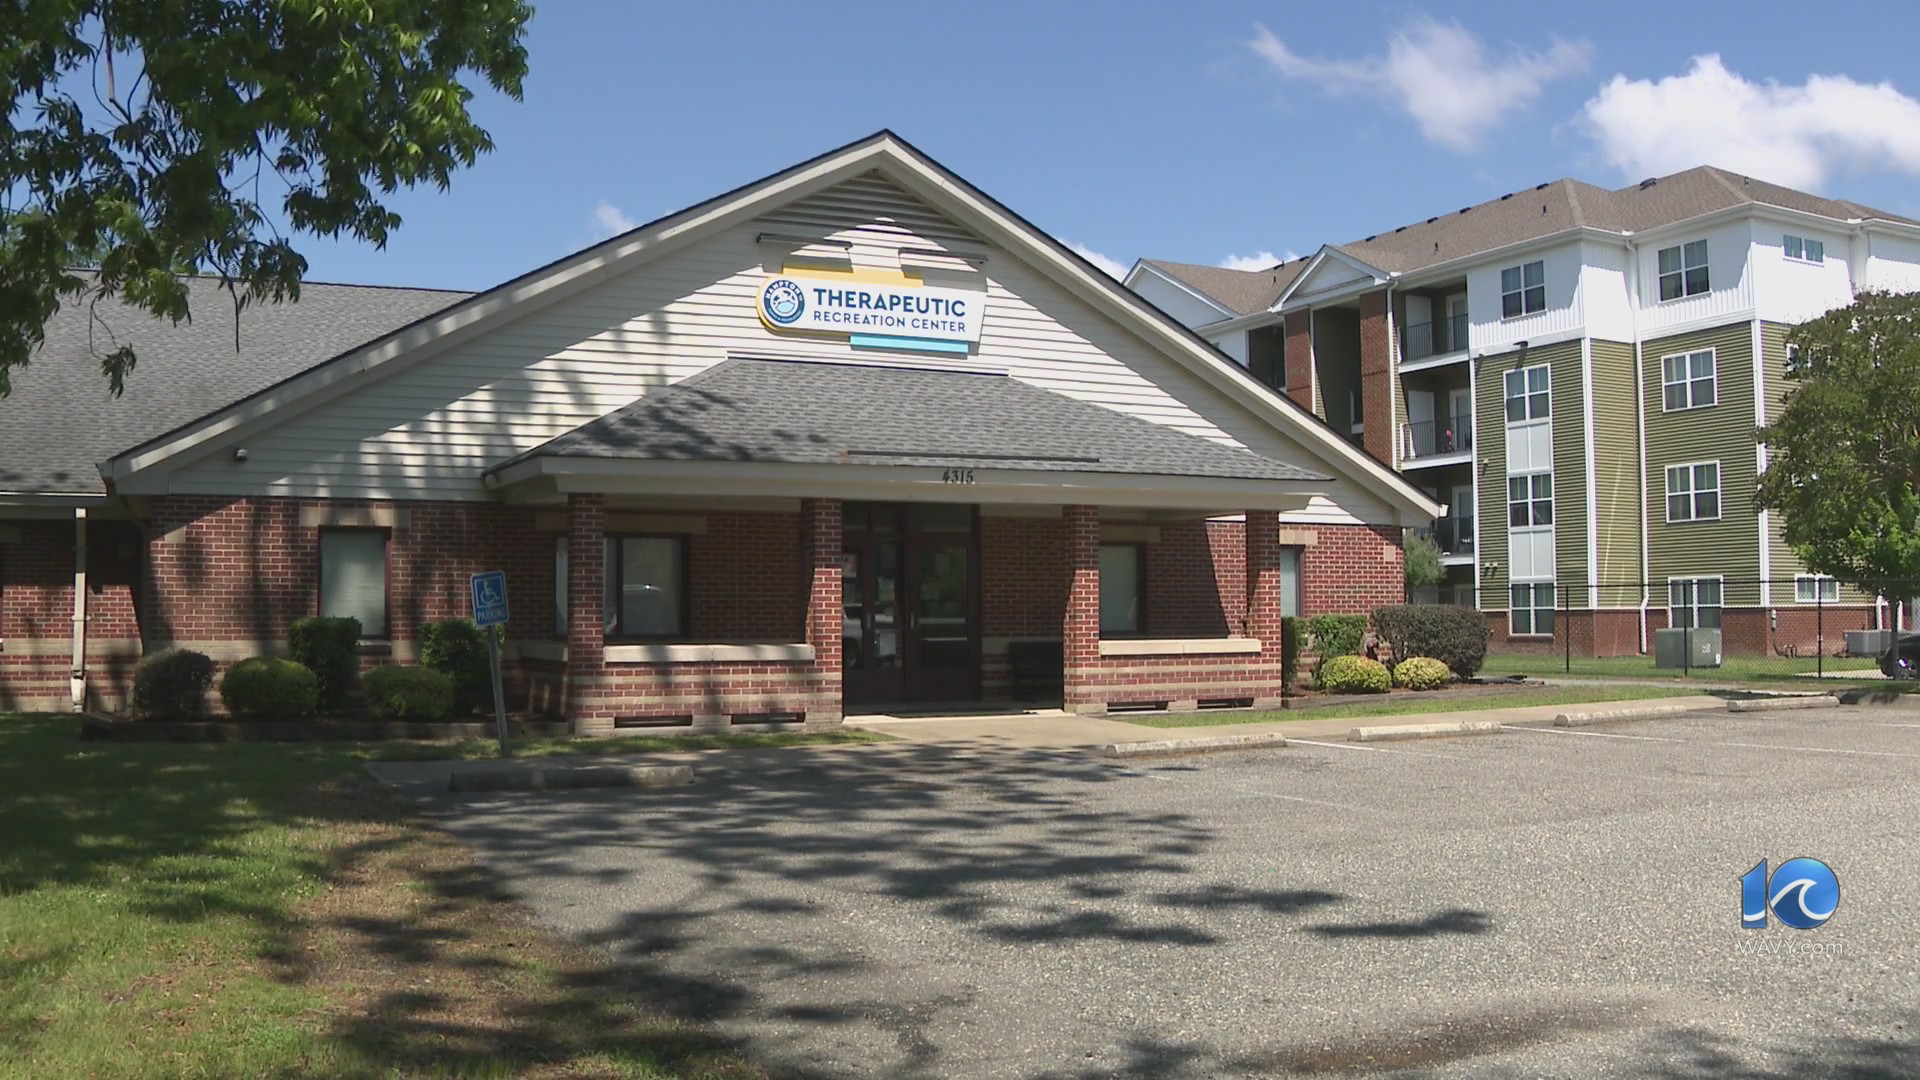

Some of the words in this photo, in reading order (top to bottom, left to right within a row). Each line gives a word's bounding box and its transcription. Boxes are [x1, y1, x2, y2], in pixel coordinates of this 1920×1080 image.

[765, 281, 801, 299] HAMPTON
[813, 288, 966, 317] THERAPEUTIC
[813, 311, 905, 328] RECREATION
[911, 318, 966, 332] CENTER
[942, 469, 973, 483] 4315
[478, 607, 507, 621] PARKING
